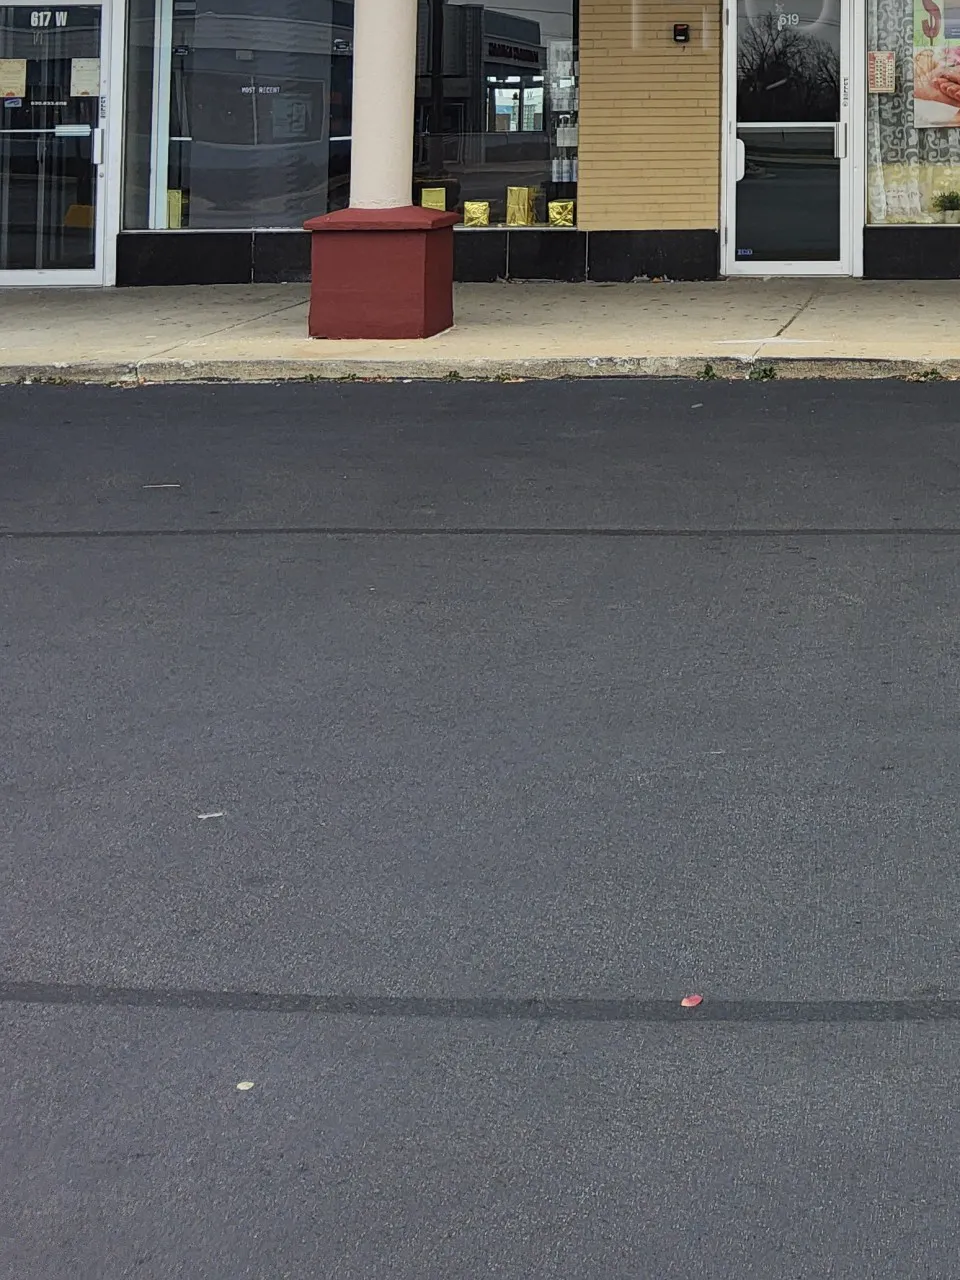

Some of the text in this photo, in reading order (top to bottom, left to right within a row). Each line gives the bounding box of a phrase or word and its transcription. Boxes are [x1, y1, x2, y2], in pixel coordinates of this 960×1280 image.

[30, 11, 68, 27] 617 W
[778, 13, 799, 26] 619
